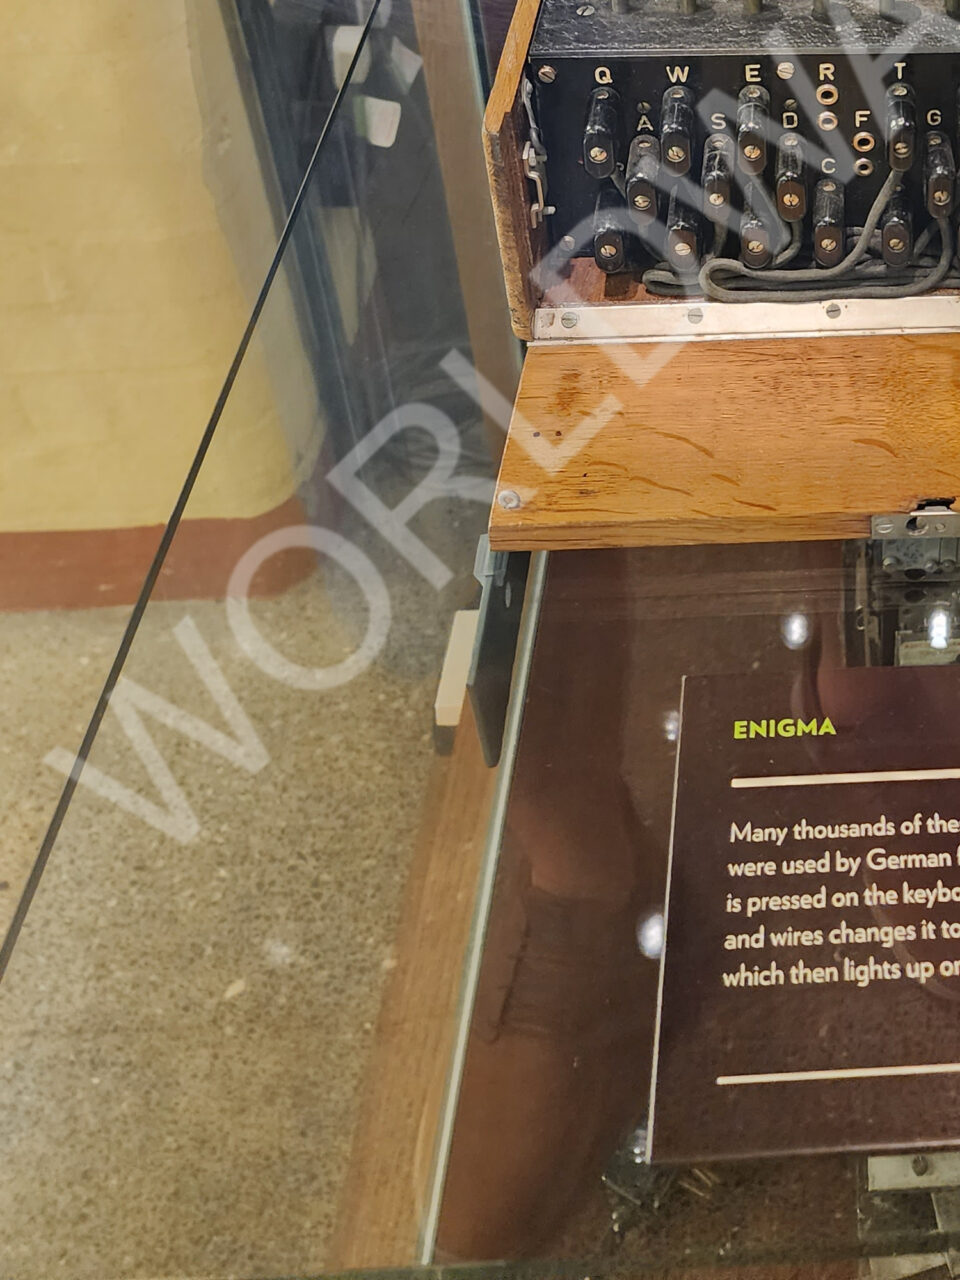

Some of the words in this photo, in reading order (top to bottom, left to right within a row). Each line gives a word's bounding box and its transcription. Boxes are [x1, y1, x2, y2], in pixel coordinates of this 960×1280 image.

[594, 66, 613, 84] Q
[665, 65, 690, 84] W
[745, 63, 761, 82] E
[819, 62, 836, 81] R
[893, 62, 907, 80] T
[733, 717, 837, 740] ENIGMA
[730, 821, 788, 846] Many
[793, 815, 896, 840] thousands
[900, 813, 922, 835] of
[727, 860, 777, 877] were
[782, 850, 831, 875] used
[835, 850, 861, 877] by
[866, 847, 952, 870] German
[726, 893, 742, 913] is
[746, 885, 827, 917] pressed
[831, 891, 859, 908] on
[863, 883, 898, 906] the
[723, 924, 765, 950] and
[769, 926, 824, 947] wires
[828, 920, 917, 948] changes
[921, 919, 936, 940] it
[722, 960, 785, 988] which
[790, 959, 839, 985] then
[843, 955, 901, 988] lights
[905, 961, 934, 985] up
